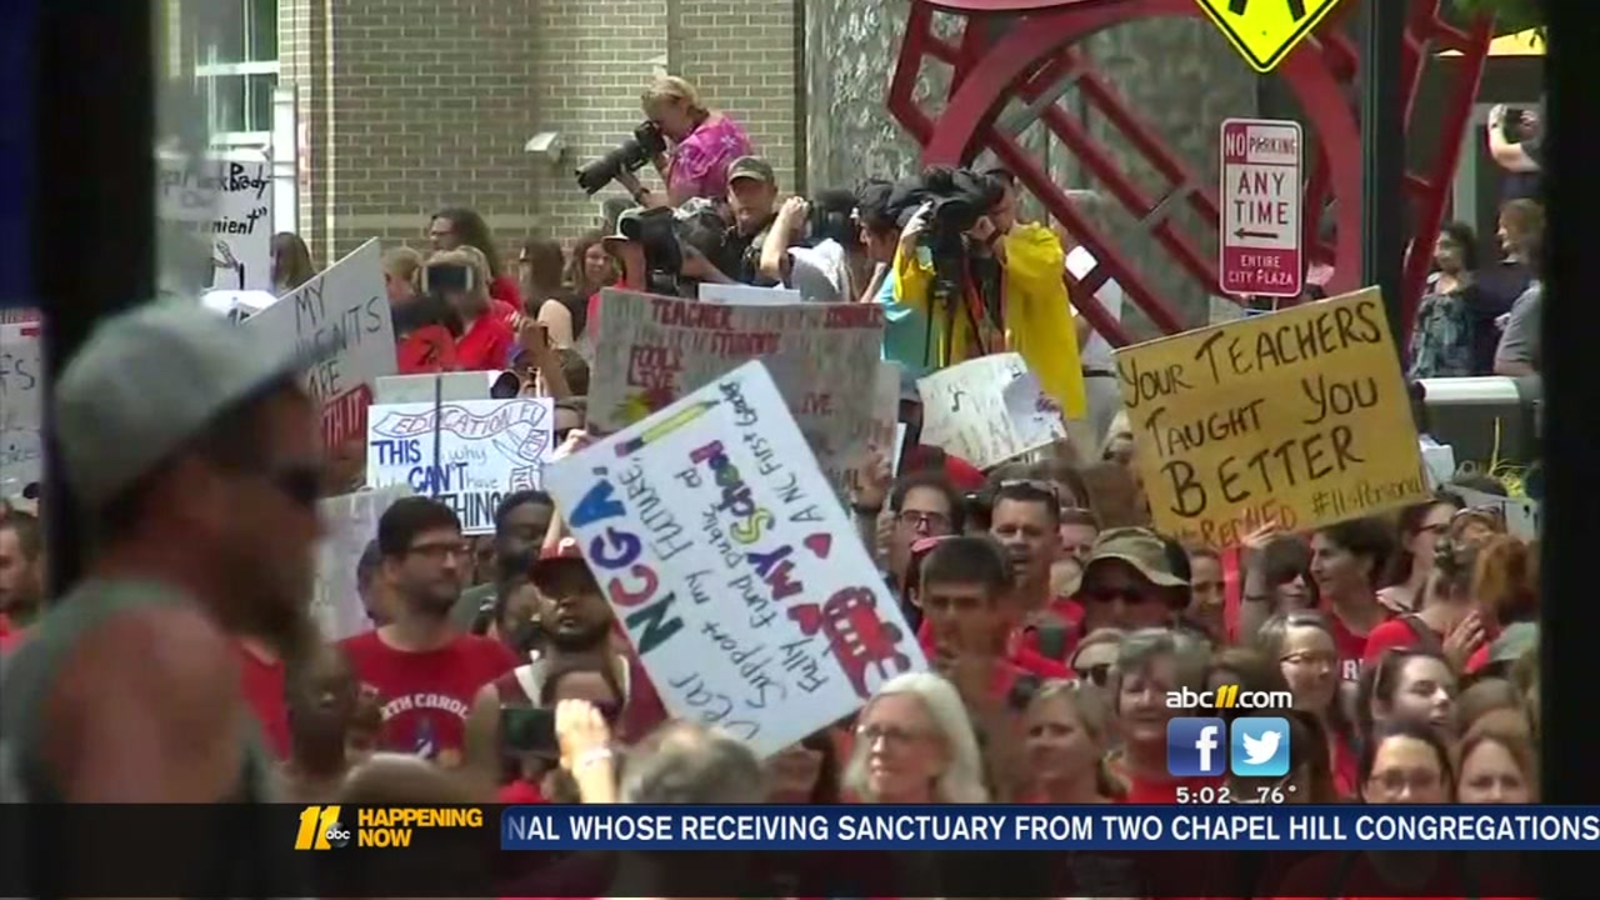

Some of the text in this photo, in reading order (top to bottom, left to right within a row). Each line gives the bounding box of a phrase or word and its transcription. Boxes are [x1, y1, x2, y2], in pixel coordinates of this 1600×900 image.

[1226, 133, 1245, 156] NO
[1238, 171, 1285, 195] ANY
[1234, 200, 1289, 224] TIME
[1241, 254, 1280, 268] ENTIRE
[1228, 269, 1294, 285] CITY PLAZA
[295, 276, 325, 334] MY
[1117, 300, 1382, 408] YOUR TEACHERS
[392, 408, 511, 434] EDCATION
[1146, 375, 1378, 456] TAUGHT YOU
[370, 439, 421, 465] THIS
[408, 462, 469, 494] CAN'T
[1161, 425, 1365, 517] BETTER
[776, 471, 801, 505] NC
[789, 504, 824, 524] A
[746, 543, 804, 601] MY
[684, 570, 711, 605] my
[414, 693, 470, 719] CAROL
